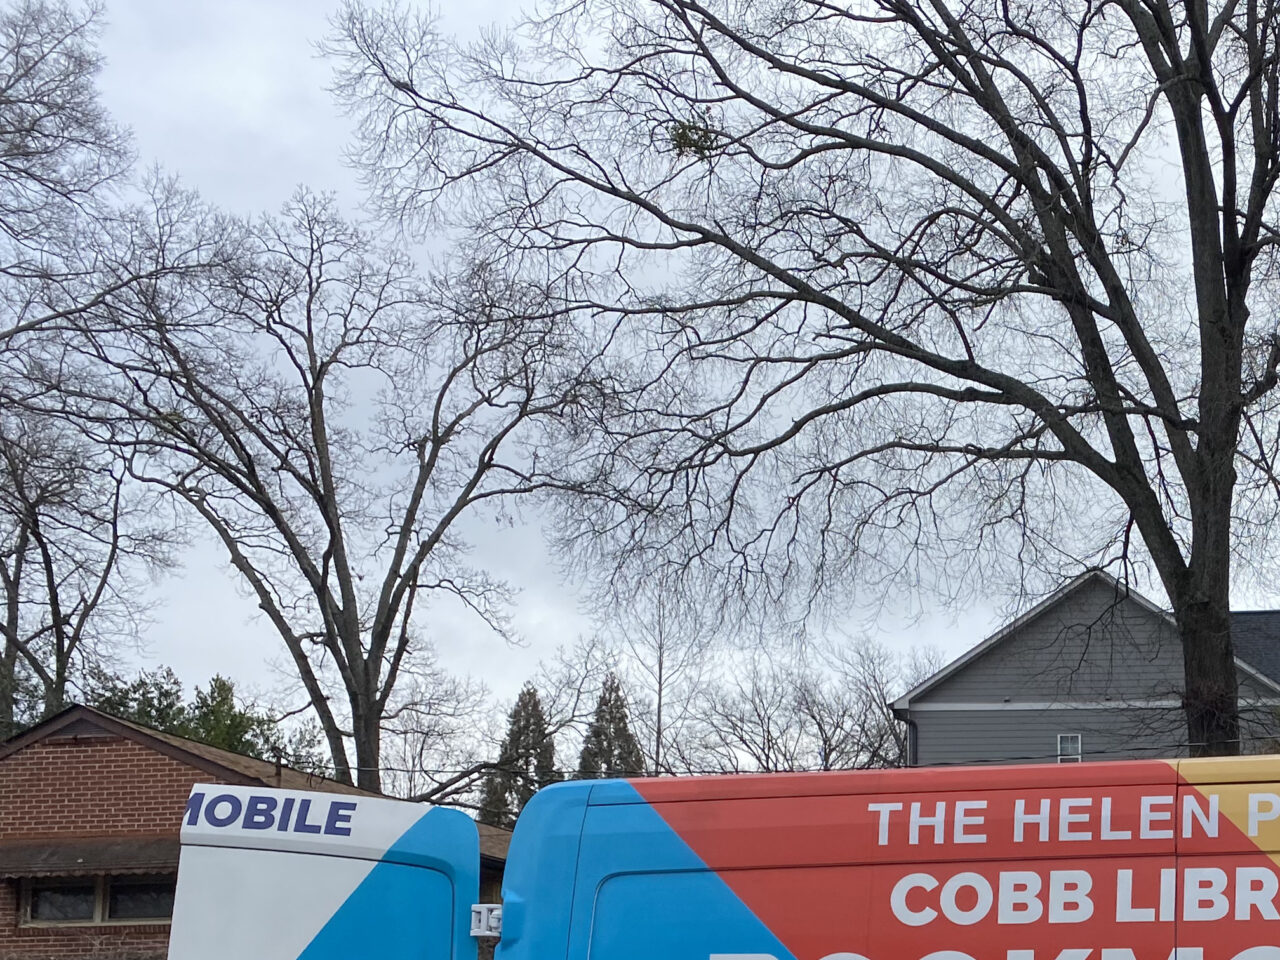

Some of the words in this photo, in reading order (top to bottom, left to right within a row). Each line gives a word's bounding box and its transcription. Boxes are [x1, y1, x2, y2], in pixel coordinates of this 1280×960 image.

[868, 801, 987, 845] THE
[1013, 794, 1219, 842] HELEN
[891, 870, 1094, 926] COBB
